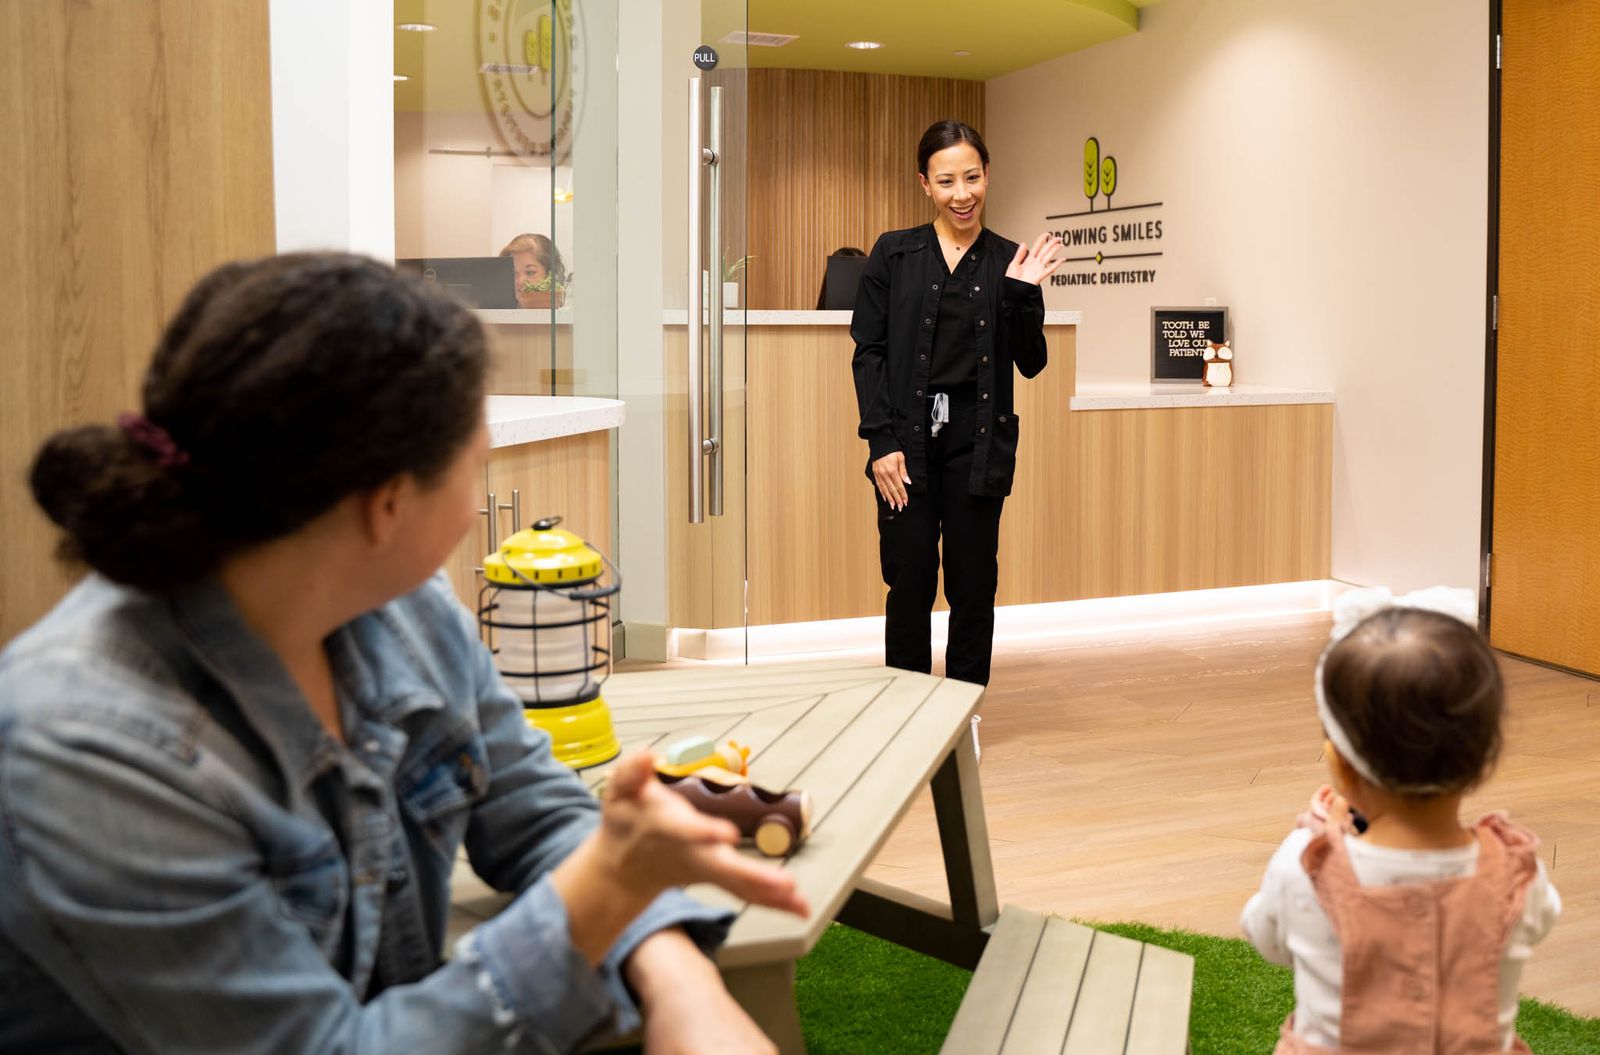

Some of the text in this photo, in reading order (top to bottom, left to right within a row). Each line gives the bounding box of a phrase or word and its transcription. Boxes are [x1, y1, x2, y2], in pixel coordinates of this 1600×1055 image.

[694, 53, 716, 62] PULL
[1112, 220, 1163, 242] SMILES
[1050, 270, 1156, 286] PEDIATRIC DENTISTRY
[1162, 321, 1210, 329] TOOTH BE
[1162, 330, 1205, 338] TOLD WE
[1168, 339, 1190, 347] LOVE
[1169, 348, 1204, 356] PATIENT
